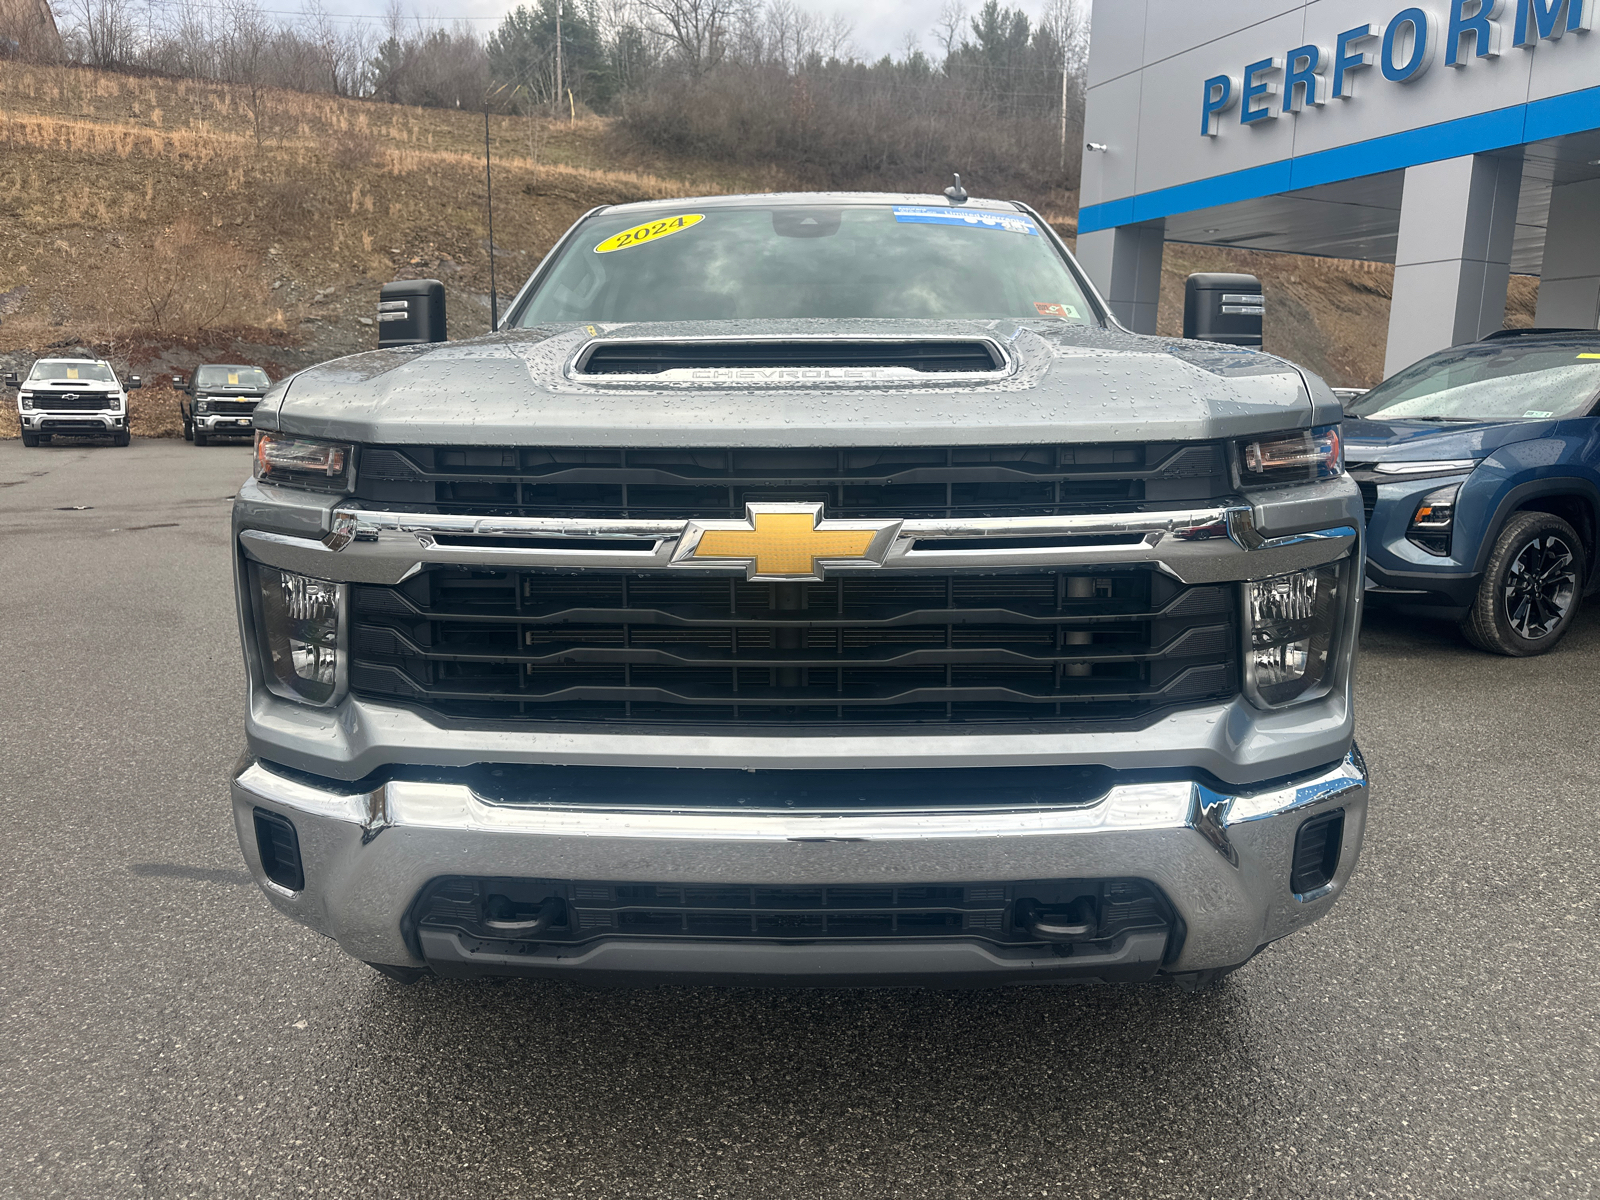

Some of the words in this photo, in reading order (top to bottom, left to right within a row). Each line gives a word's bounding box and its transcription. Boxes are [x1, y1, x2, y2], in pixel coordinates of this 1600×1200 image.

[1200, 0, 1592, 137] PERFORM
[944, 210, 980, 218] Limited
[616, 217, 687, 248] 2024
[692, 370, 884, 379] CHEVROLET
